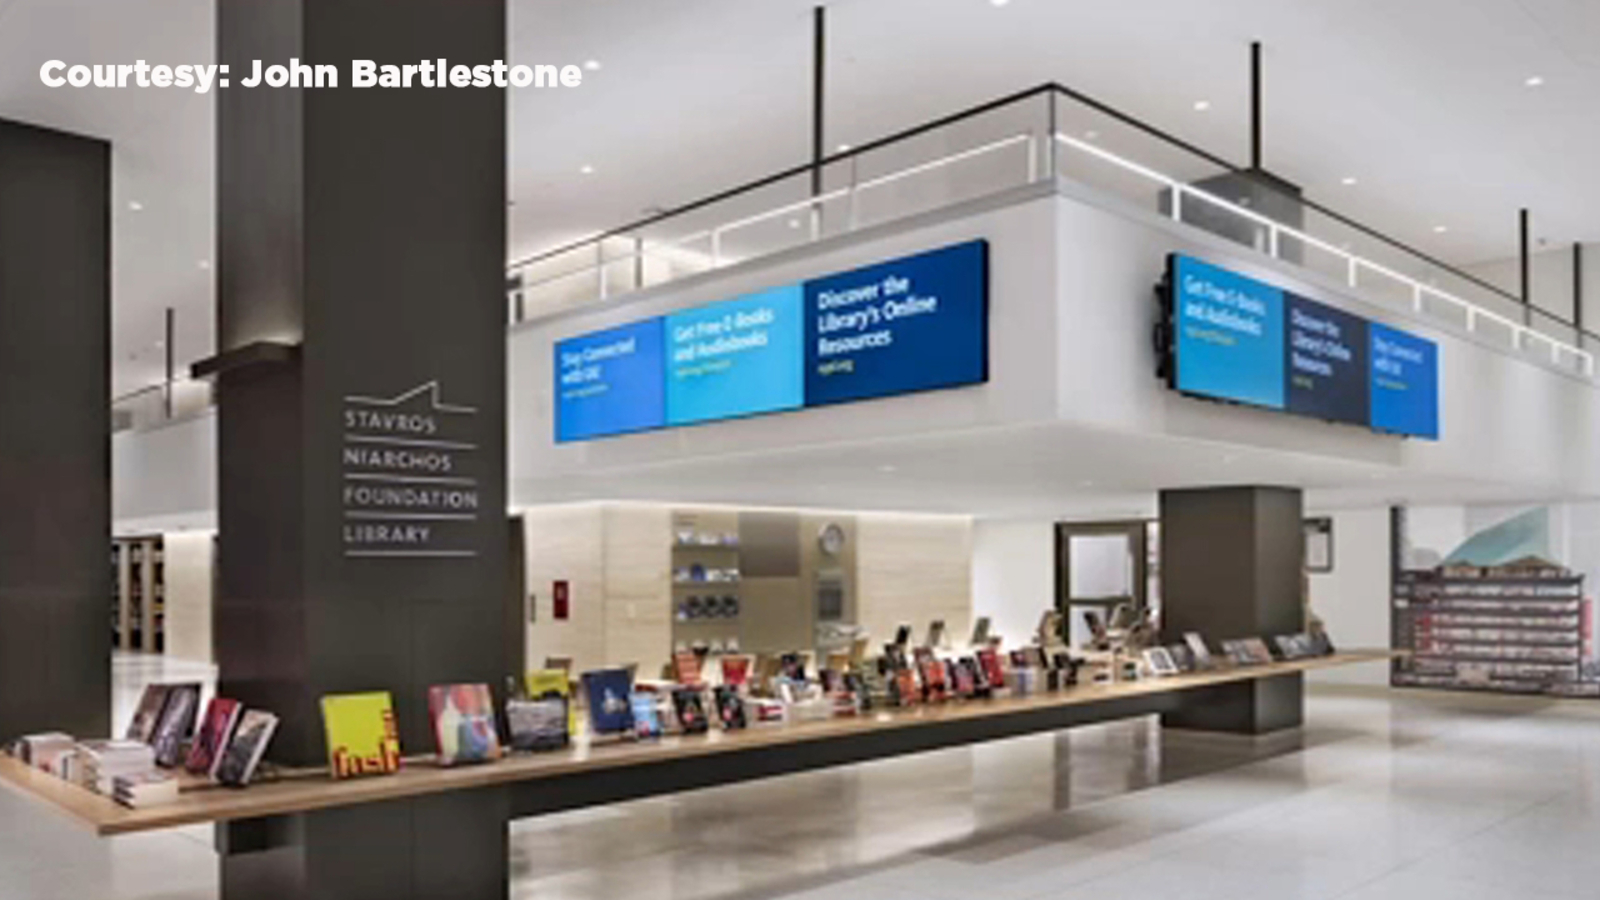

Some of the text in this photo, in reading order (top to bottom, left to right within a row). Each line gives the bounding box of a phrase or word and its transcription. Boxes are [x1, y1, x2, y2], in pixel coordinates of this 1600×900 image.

[818, 275, 909, 310] Discover the
[818, 295, 938, 333] Library's Online
[818, 330, 894, 357] Resources
[344, 410, 437, 435] STAVROS
[343, 448, 452, 472] NIARCHOS
[343, 486, 478, 509] FOUNDATION
[343, 525, 431, 543] LIBRARY
